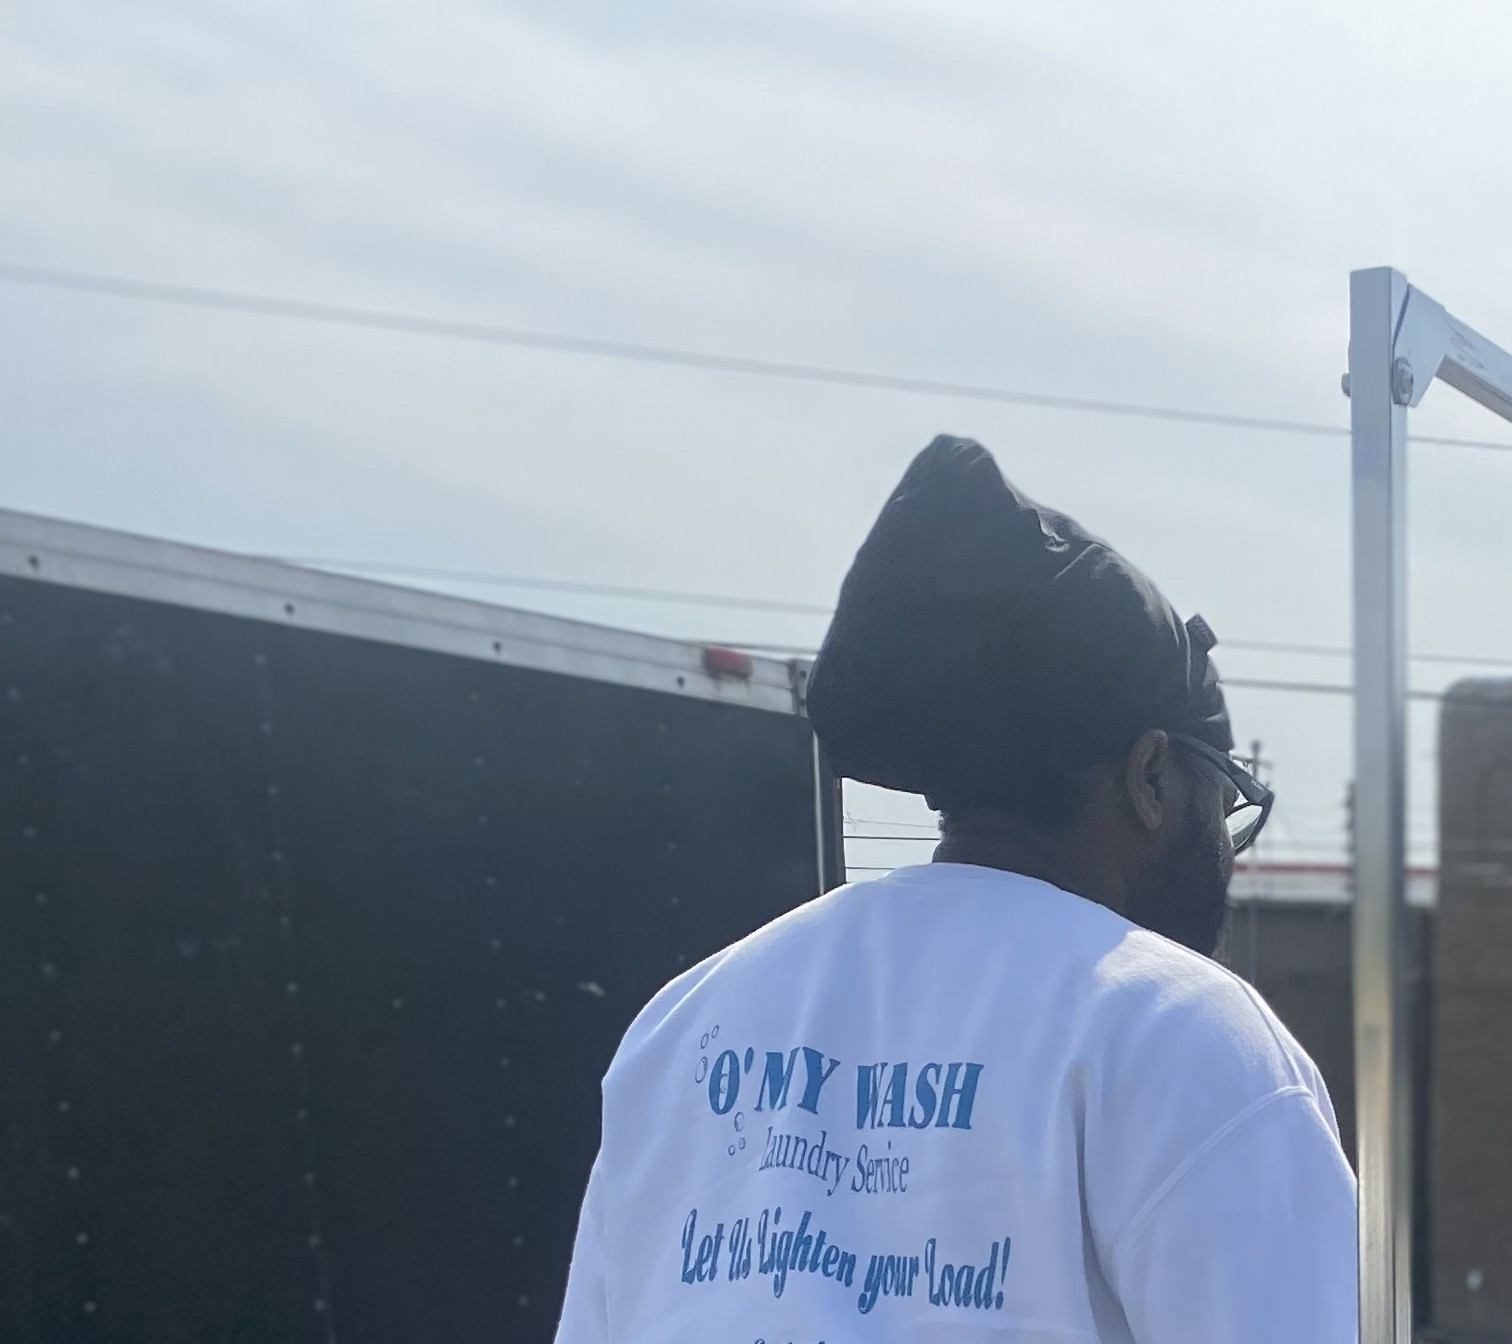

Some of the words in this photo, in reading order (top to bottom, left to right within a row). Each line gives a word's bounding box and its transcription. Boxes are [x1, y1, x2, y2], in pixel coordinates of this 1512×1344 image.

[708, 1046, 841, 1115] O'MY
[856, 1061, 985, 1130] WASH
[850, 1140, 910, 1194] Service
[681, 1208, 726, 1285] Let
[728, 1217, 752, 1281] Us
[757, 1206, 857, 1299] Lighten
[857, 1254, 920, 1315] your
[924, 1236, 1011, 1310] Load!
